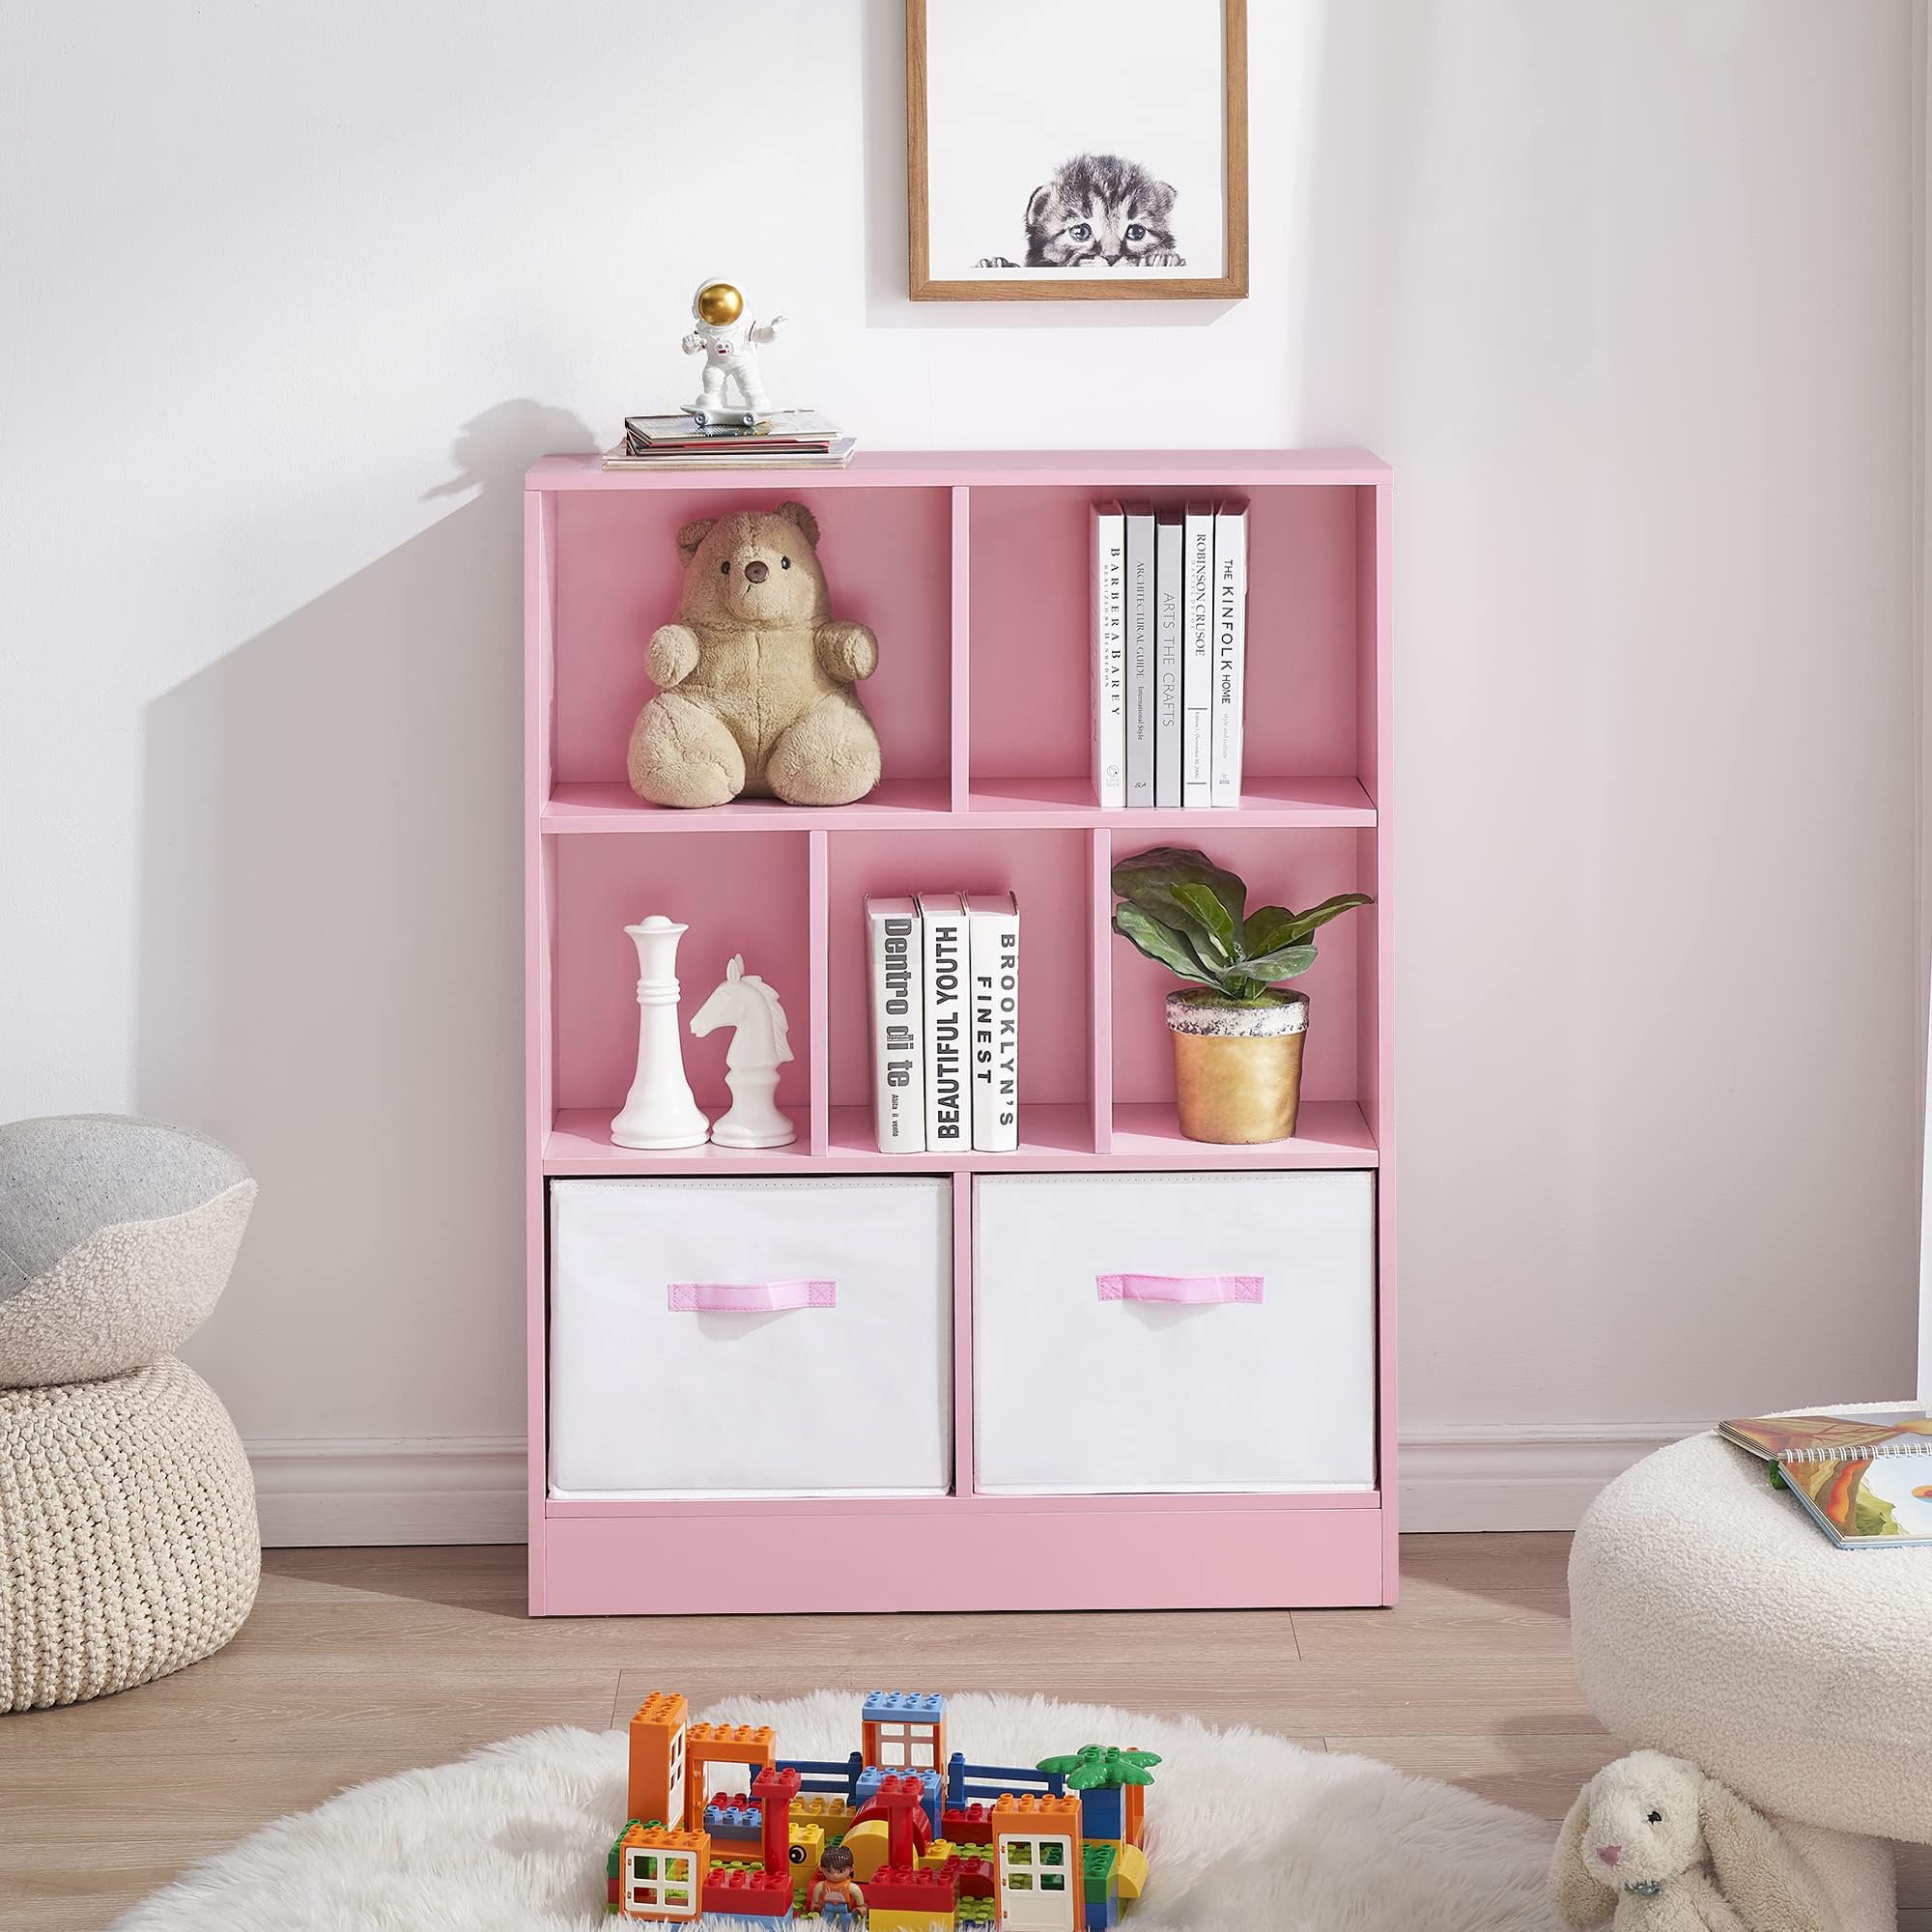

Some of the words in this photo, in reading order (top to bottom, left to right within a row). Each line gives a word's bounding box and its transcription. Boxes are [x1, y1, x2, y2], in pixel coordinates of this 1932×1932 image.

[1111, 548, 1120, 640] BARBERA
[1196, 533, 1207, 602] ROBINSON
[1224, 558, 1233, 580] THE
[1136, 560, 1145, 644] ARCHITECTURAL
[1163, 593, 1175, 630] ARTS
[1195, 604, 1207, 657] CRUSOE
[1221, 585, 1235, 670] KINFOLK
[1111, 650, 1121, 716] BAREY
[1136, 646, 1145, 679] GUIDE
[1163, 637, 1175, 666] THE
[1162, 671, 1175, 727] CRAFTS
[1221, 674, 1231, 704] HOME
[884, 919, 912, 1015] Dentro
[935, 926, 958, 1005] YOUTH
[886, 1025, 914, 1050] di
[977, 977, 992, 1084] FINEST
[999, 933, 1015, 1125] BROOKLYN'S
[887, 1060, 913, 1087] te
[937, 1011, 959, 1139] BEAUTIFUL
